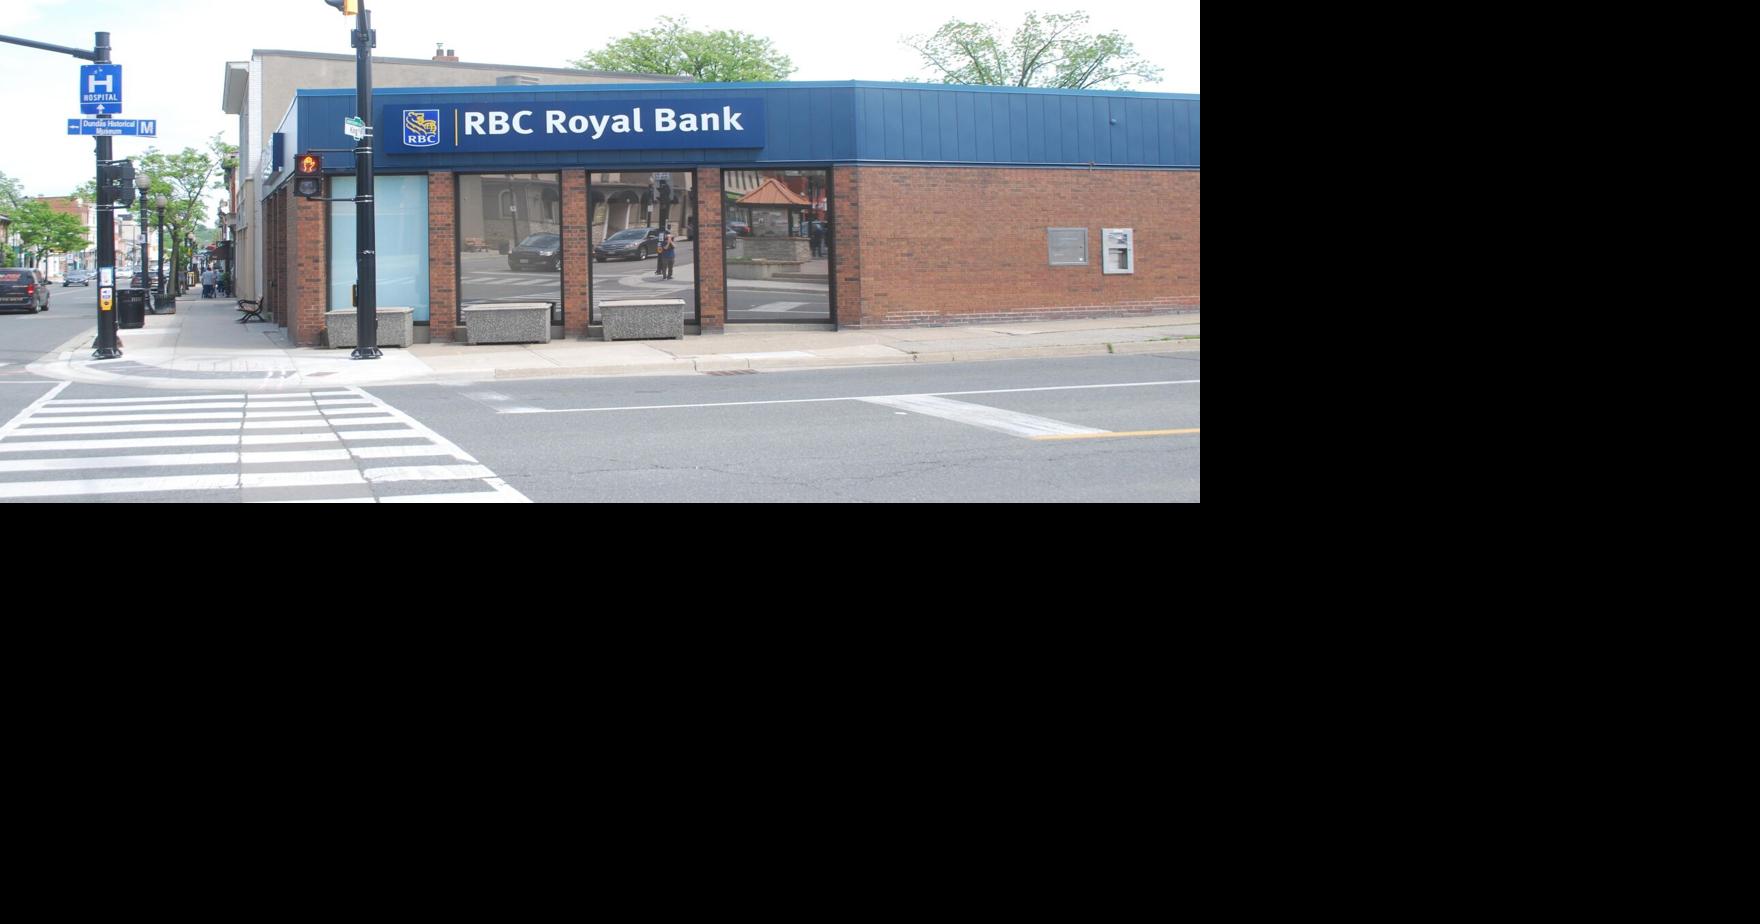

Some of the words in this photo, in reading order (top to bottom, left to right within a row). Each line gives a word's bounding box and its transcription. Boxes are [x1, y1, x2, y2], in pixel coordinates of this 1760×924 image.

[88, 74, 113, 93] H
[83, 94, 118, 102] HOSPITAL
[107, 120, 136, 128] Historical
[140, 121, 154, 134] M
[464, 110, 534, 135] RBC
[545, 107, 644, 140] Royal
[654, 105, 744, 132] Bank
[408, 135, 436, 143] RBC
